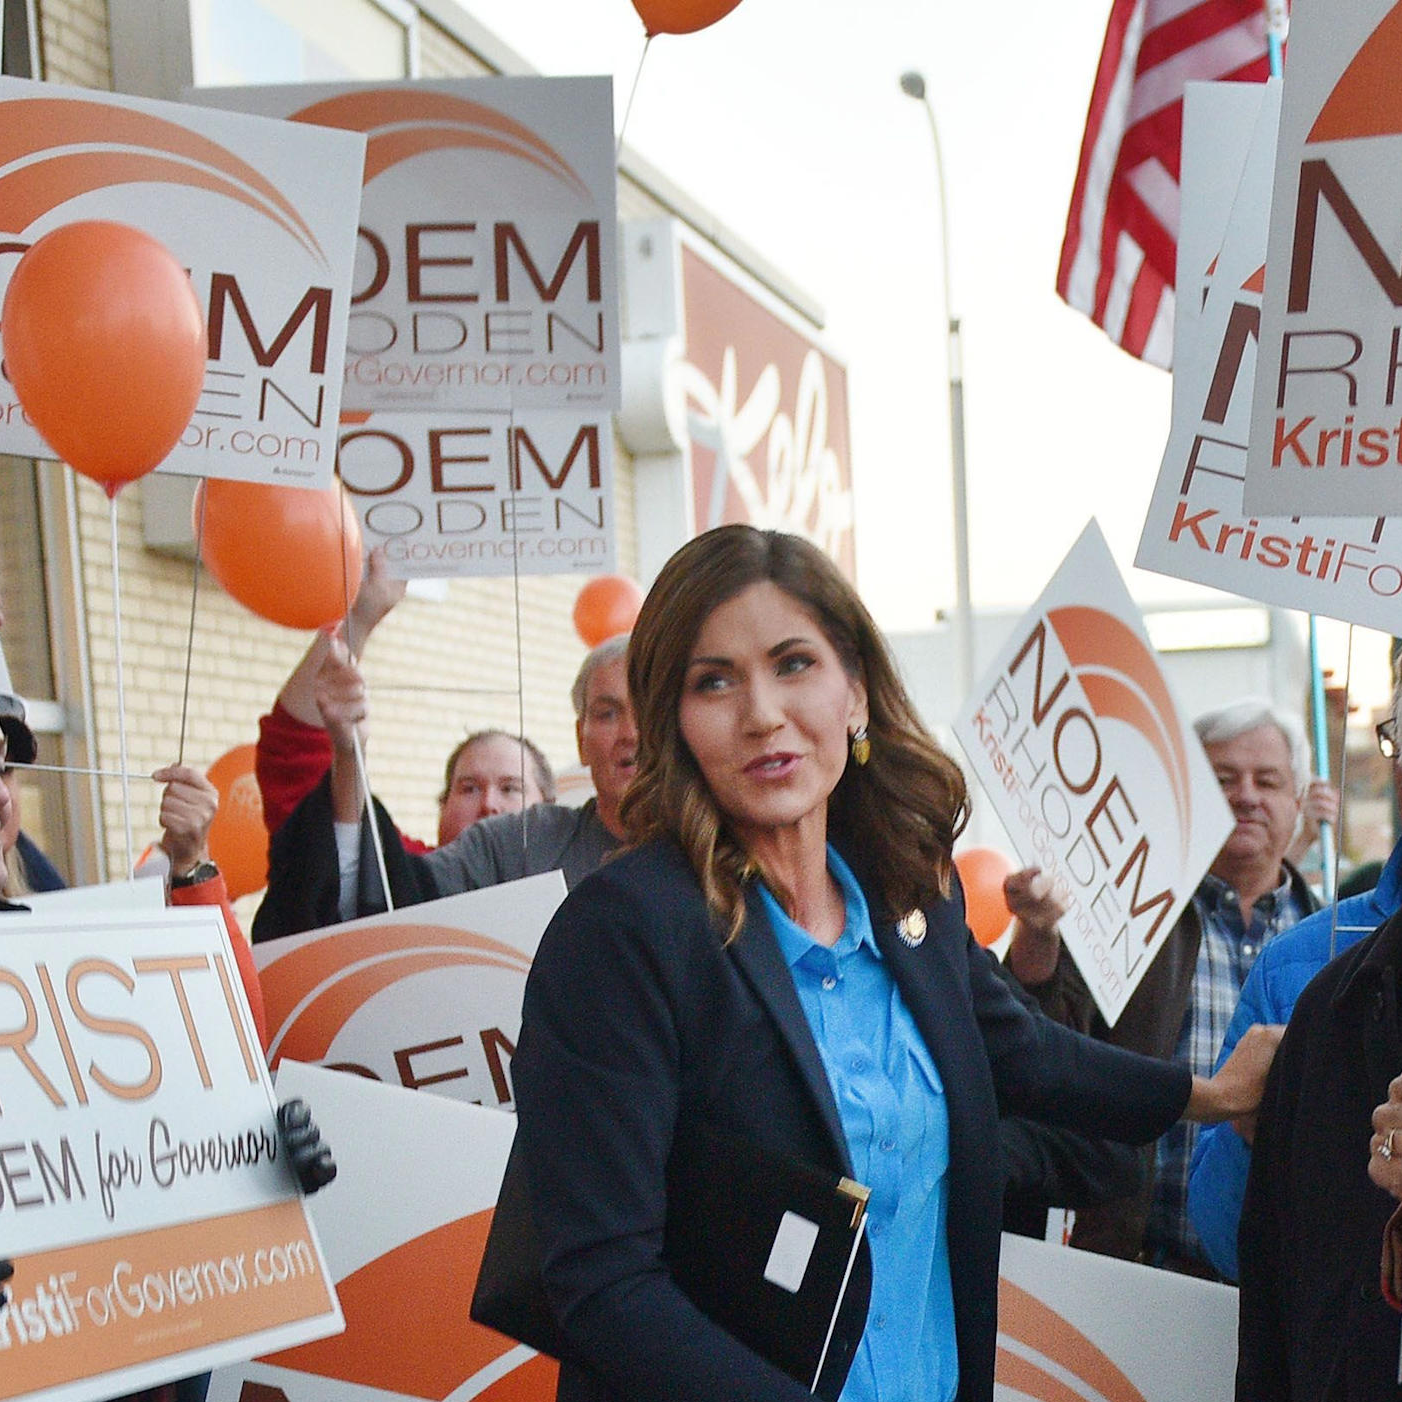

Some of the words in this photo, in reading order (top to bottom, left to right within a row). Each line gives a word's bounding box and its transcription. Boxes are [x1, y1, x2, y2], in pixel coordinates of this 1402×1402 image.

[346, 310, 605, 355] ODEN
[344, 355, 608, 388] Governor.com
[336, 424, 601, 497] OEM
[365, 496, 605, 537] ODEN
[1009, 619, 1176, 947] NOEM
[984, 675, 1146, 980] RHODEN
[95, 1130, 143, 1221] for
[148, 1116, 280, 1190] Governor
